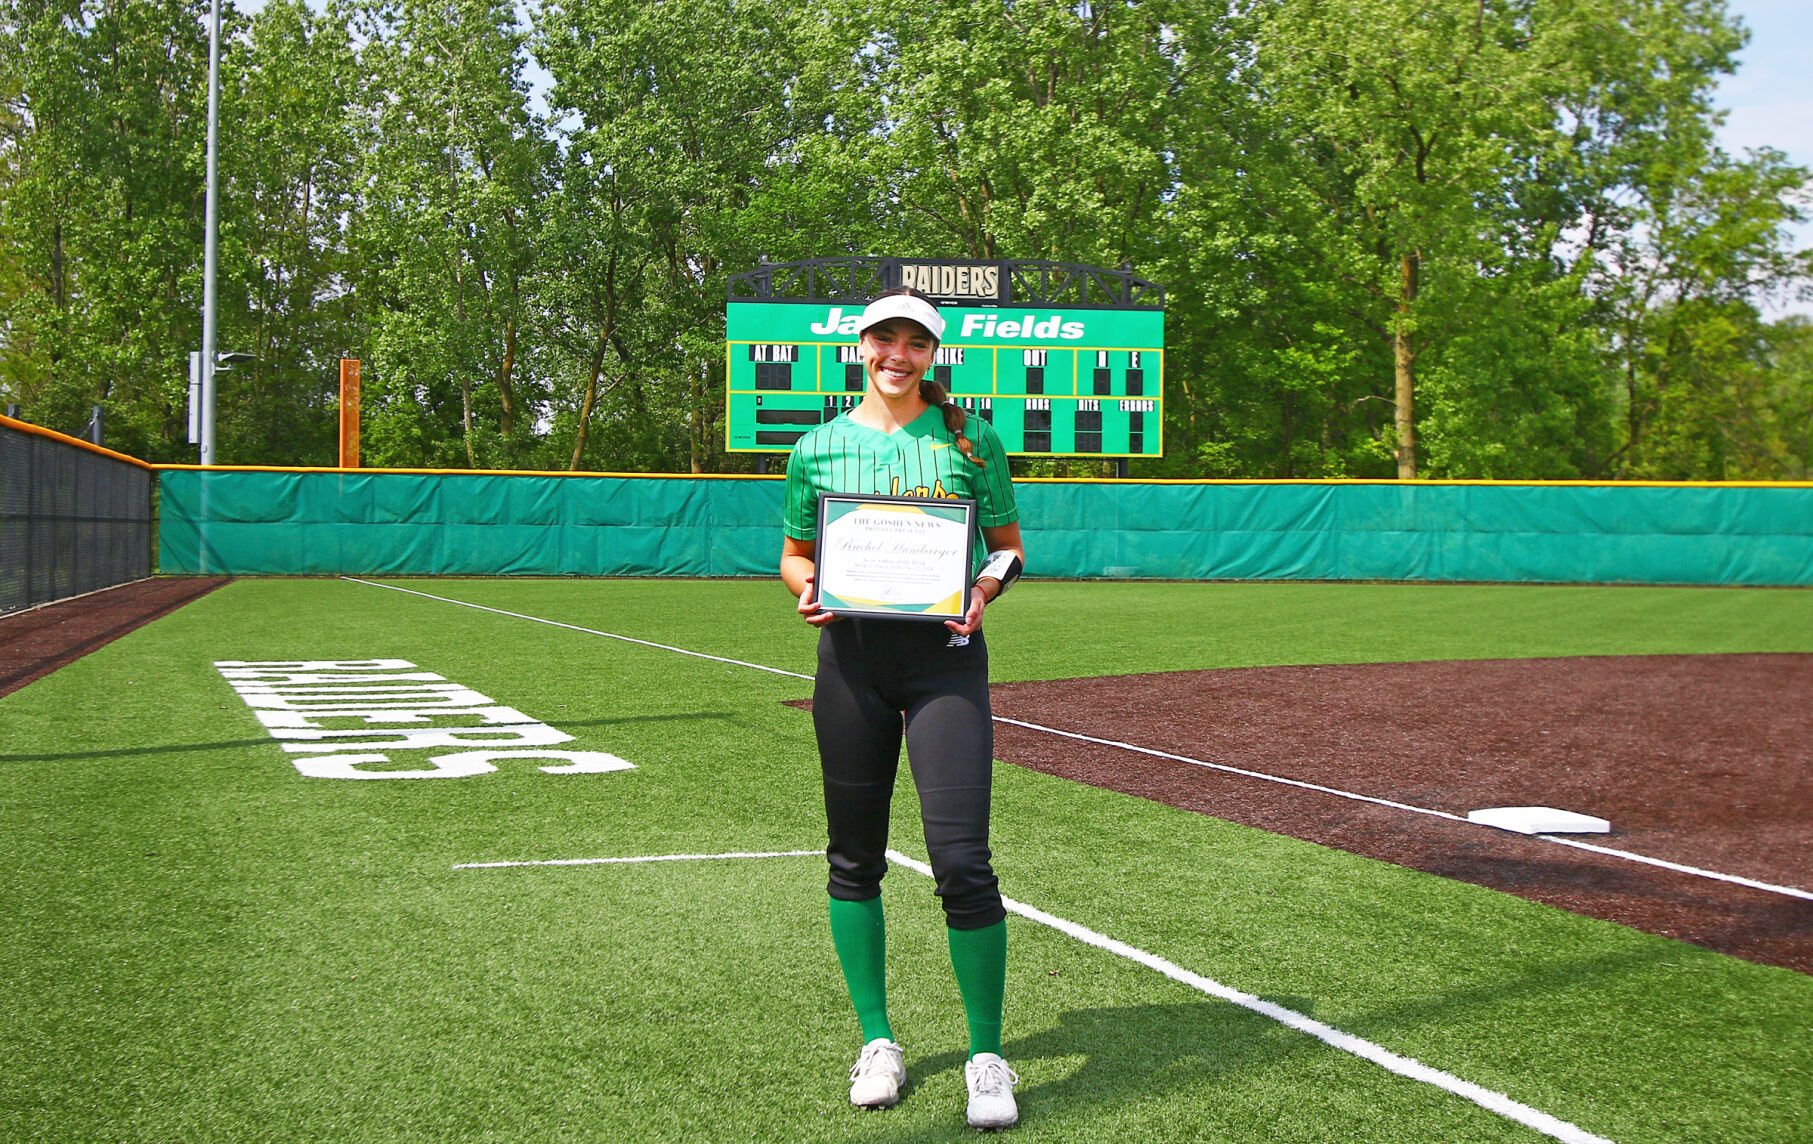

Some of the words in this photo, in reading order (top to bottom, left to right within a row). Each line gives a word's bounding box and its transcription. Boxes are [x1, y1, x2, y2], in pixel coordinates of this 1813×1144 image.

[902, 265, 998, 297] RAIDERS
[960, 313, 1084, 339] Fields
[754, 345, 767, 361] AT
[772, 345, 793, 361] BAT
[841, 346, 864, 362] BAL
[934, 347, 963, 364] RIKE
[1023, 349, 1047, 366] OUT
[1131, 352, 1138, 368] E
[845, 396, 851, 407] 2
[981, 398, 991, 409] 10
[1026, 398, 1050, 410] RUNS
[1119, 400, 1154, 412] ERRORS
[854, 517, 870, 525] THE
[873, 519, 912, 527] GOSHEN
[835, 536, 884, 552] Rachel
[213, 658, 639, 779] RAIDERS
